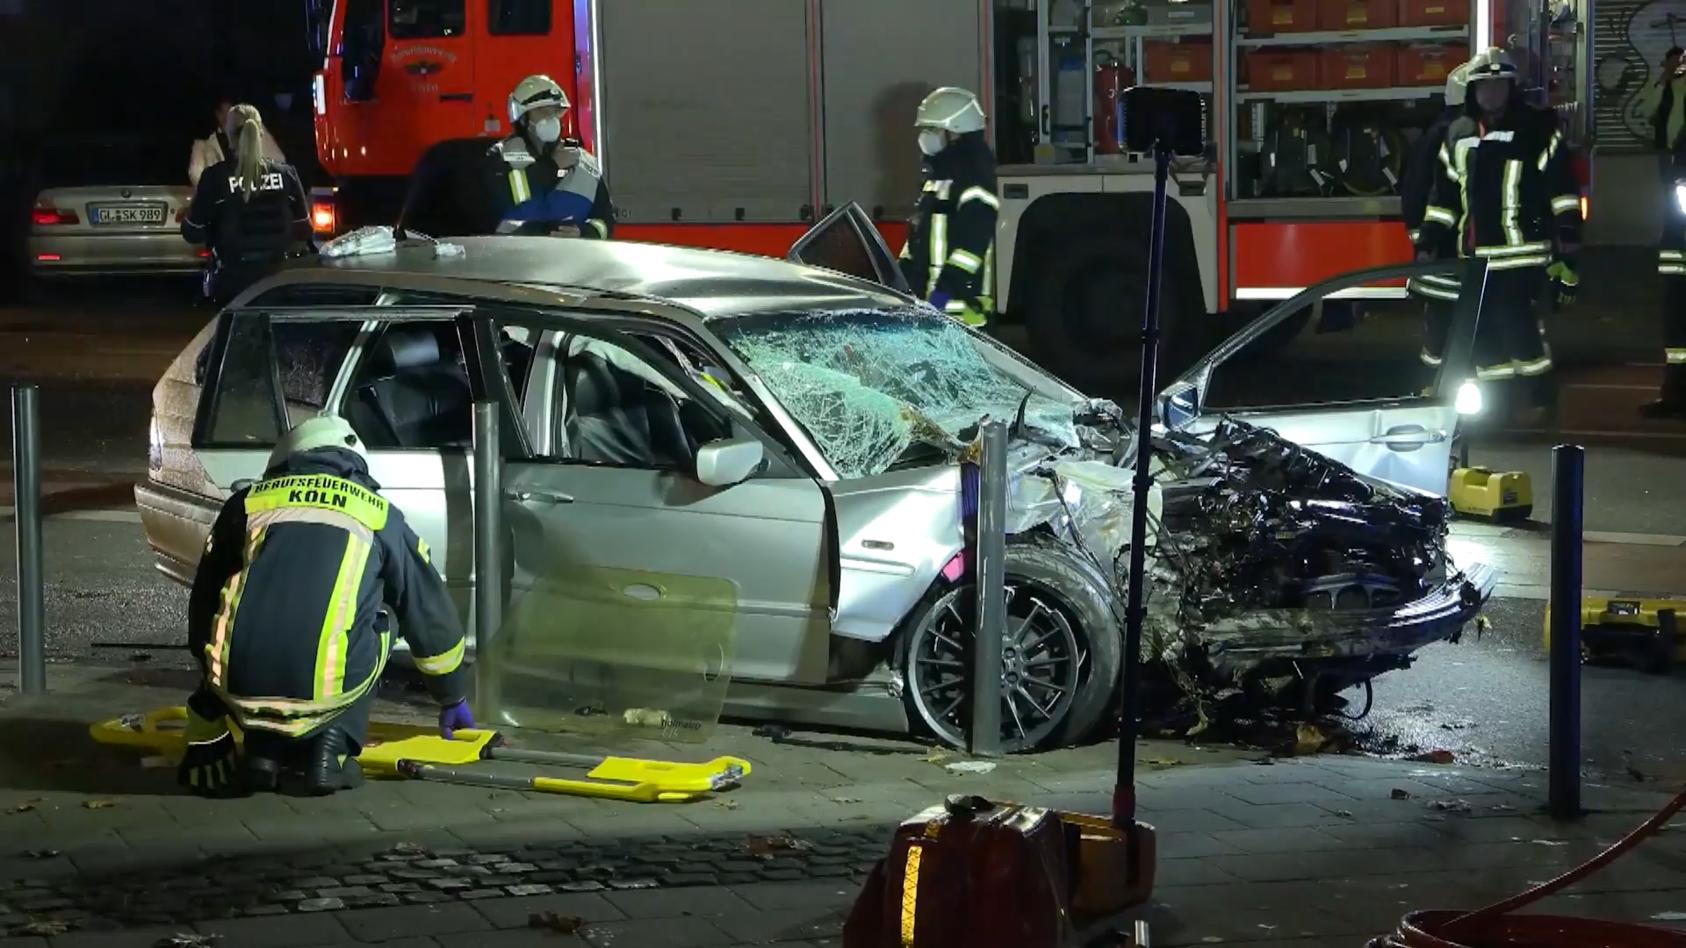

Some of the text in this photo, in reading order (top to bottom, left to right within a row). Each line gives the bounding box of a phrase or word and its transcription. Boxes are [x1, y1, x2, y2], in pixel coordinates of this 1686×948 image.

[228, 173, 284, 194] POLZEI
[122, 209, 137, 220] SK
[139, 209, 161, 221] 989
[254, 477, 384, 511] BERUFSFEUERWEHR
[288, 488, 347, 508] KÖLN
